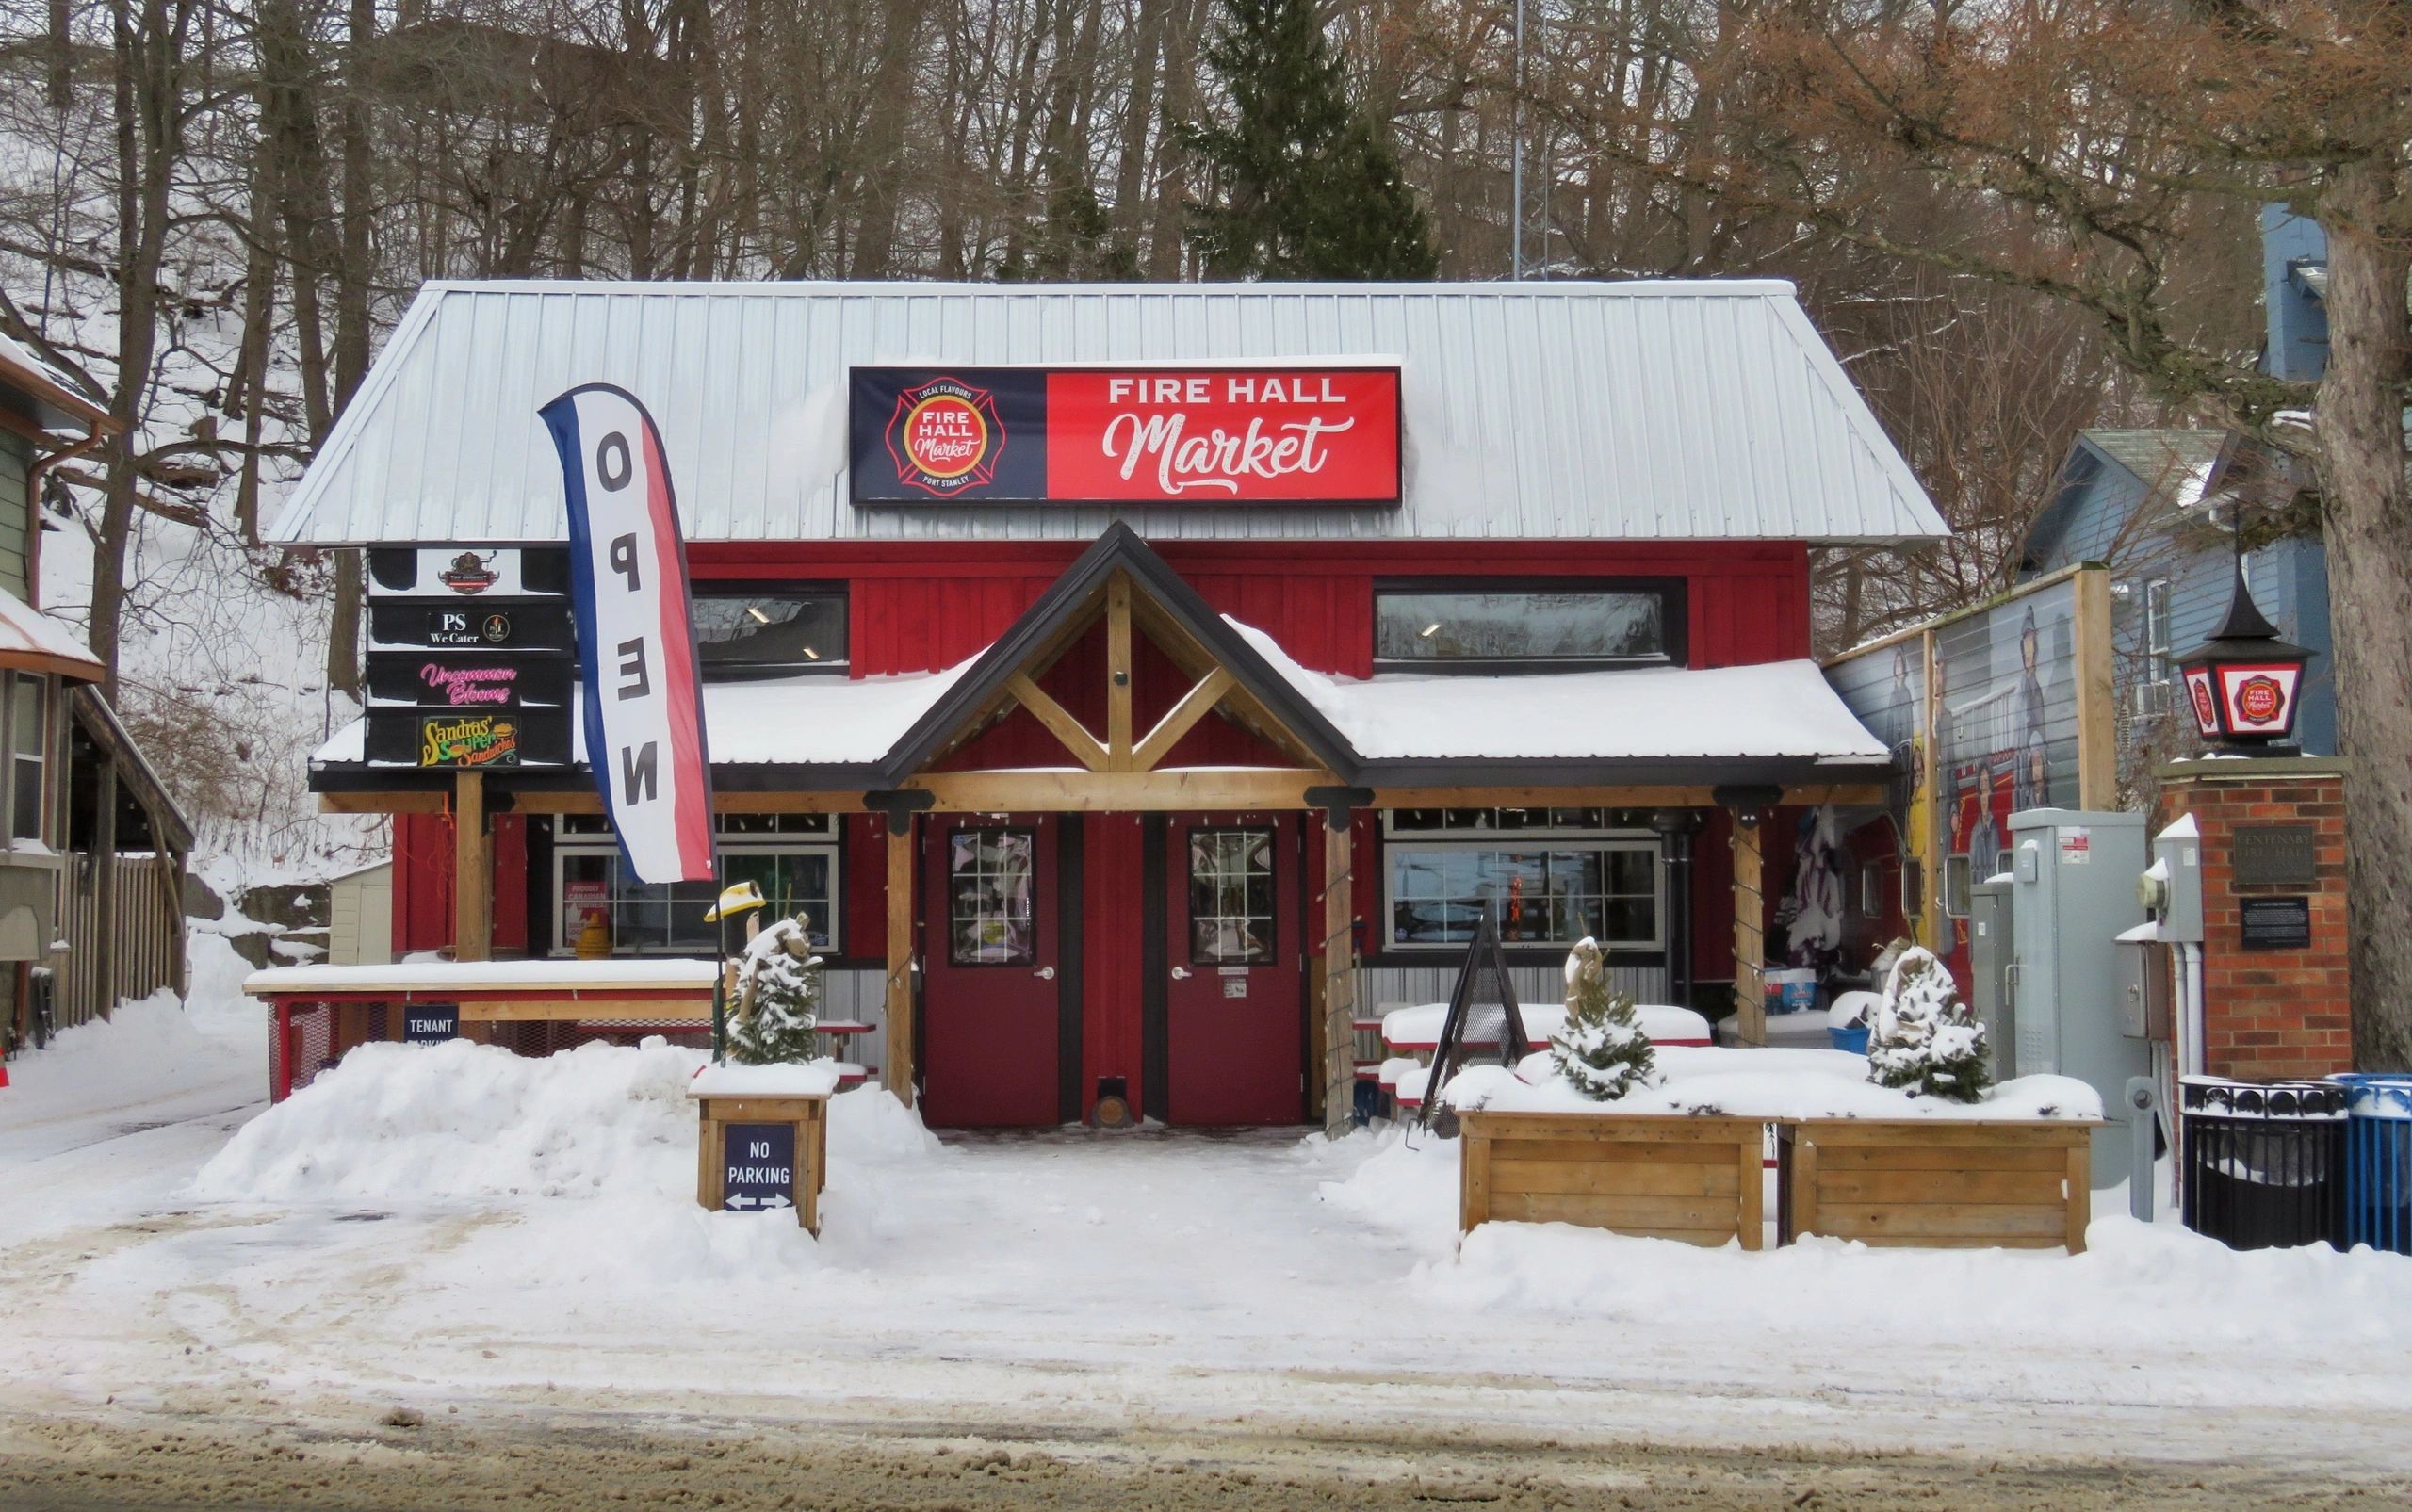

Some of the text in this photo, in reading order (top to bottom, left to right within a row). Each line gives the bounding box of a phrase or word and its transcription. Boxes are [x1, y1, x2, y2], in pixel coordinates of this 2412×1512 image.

[919, 385, 972, 399] LOCAL FLAVOURS
[1109, 378, 1346, 403] FIRE HALL
[922, 412, 970, 424] FIRE
[919, 425, 973, 436] HALL
[914, 437, 981, 463] Market
[1102, 413, 1355, 496] Market
[922, 475, 970, 487] PORT STANLEY
[442, 613, 467, 632] PS
[430, 633, 479, 643] We Cater
[420, 663, 517, 687] Uncommon
[446, 679, 510, 705] Blooms
[410, 1019, 453, 1033] TENANT
[750, 1141, 770, 1159] NO
[728, 1166, 790, 1184] PARKING
